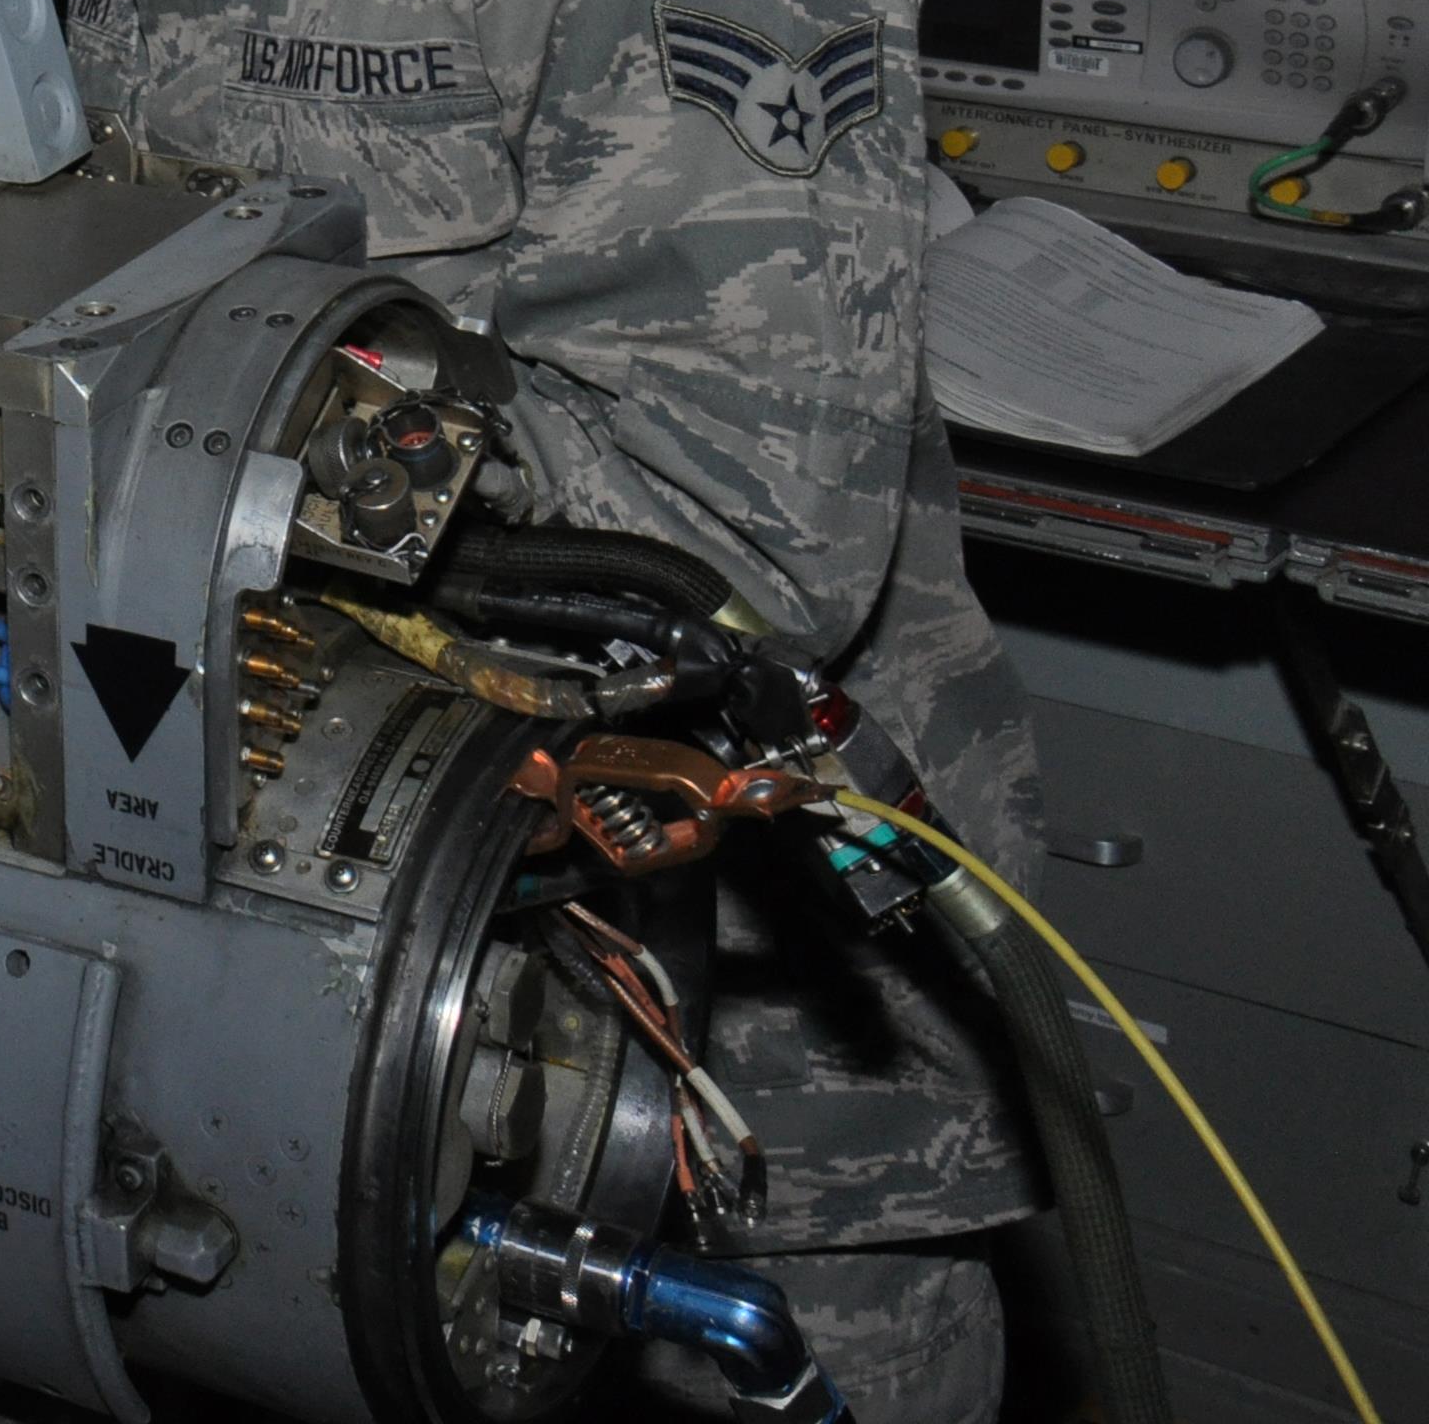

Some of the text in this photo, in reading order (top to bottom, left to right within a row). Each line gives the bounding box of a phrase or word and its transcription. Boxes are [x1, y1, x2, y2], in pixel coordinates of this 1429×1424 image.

[240, 32, 459, 97] U.S. AIR FORCE
[941, 104, 1055, 131] INTERCONNECT
[105, 788, 160, 821] AREA
[91, 842, 176, 883] CRADLE
